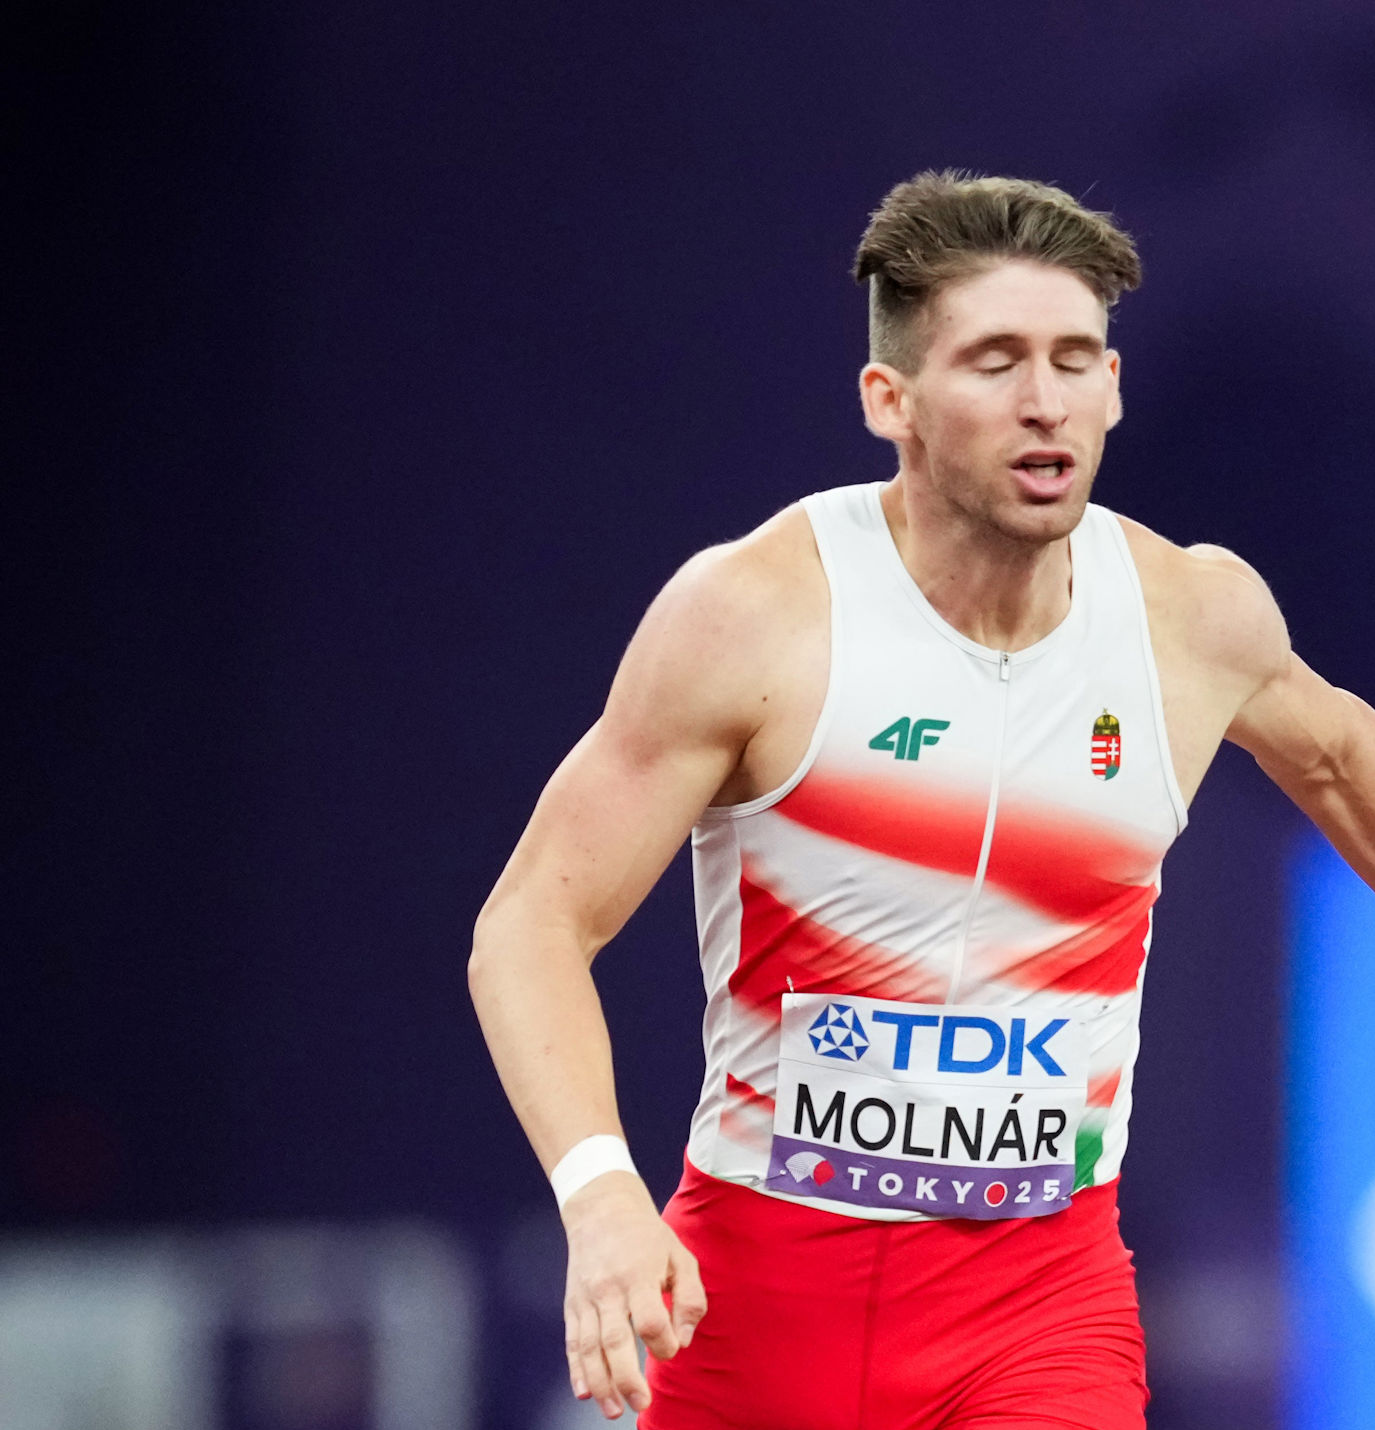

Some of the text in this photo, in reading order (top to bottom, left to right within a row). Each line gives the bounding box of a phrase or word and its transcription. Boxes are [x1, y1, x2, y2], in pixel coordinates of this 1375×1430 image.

[869, 716, 950, 761] 4F
[872, 1011, 1069, 1076] TDK
[793, 1083, 1067, 1162] MOLNÁR
